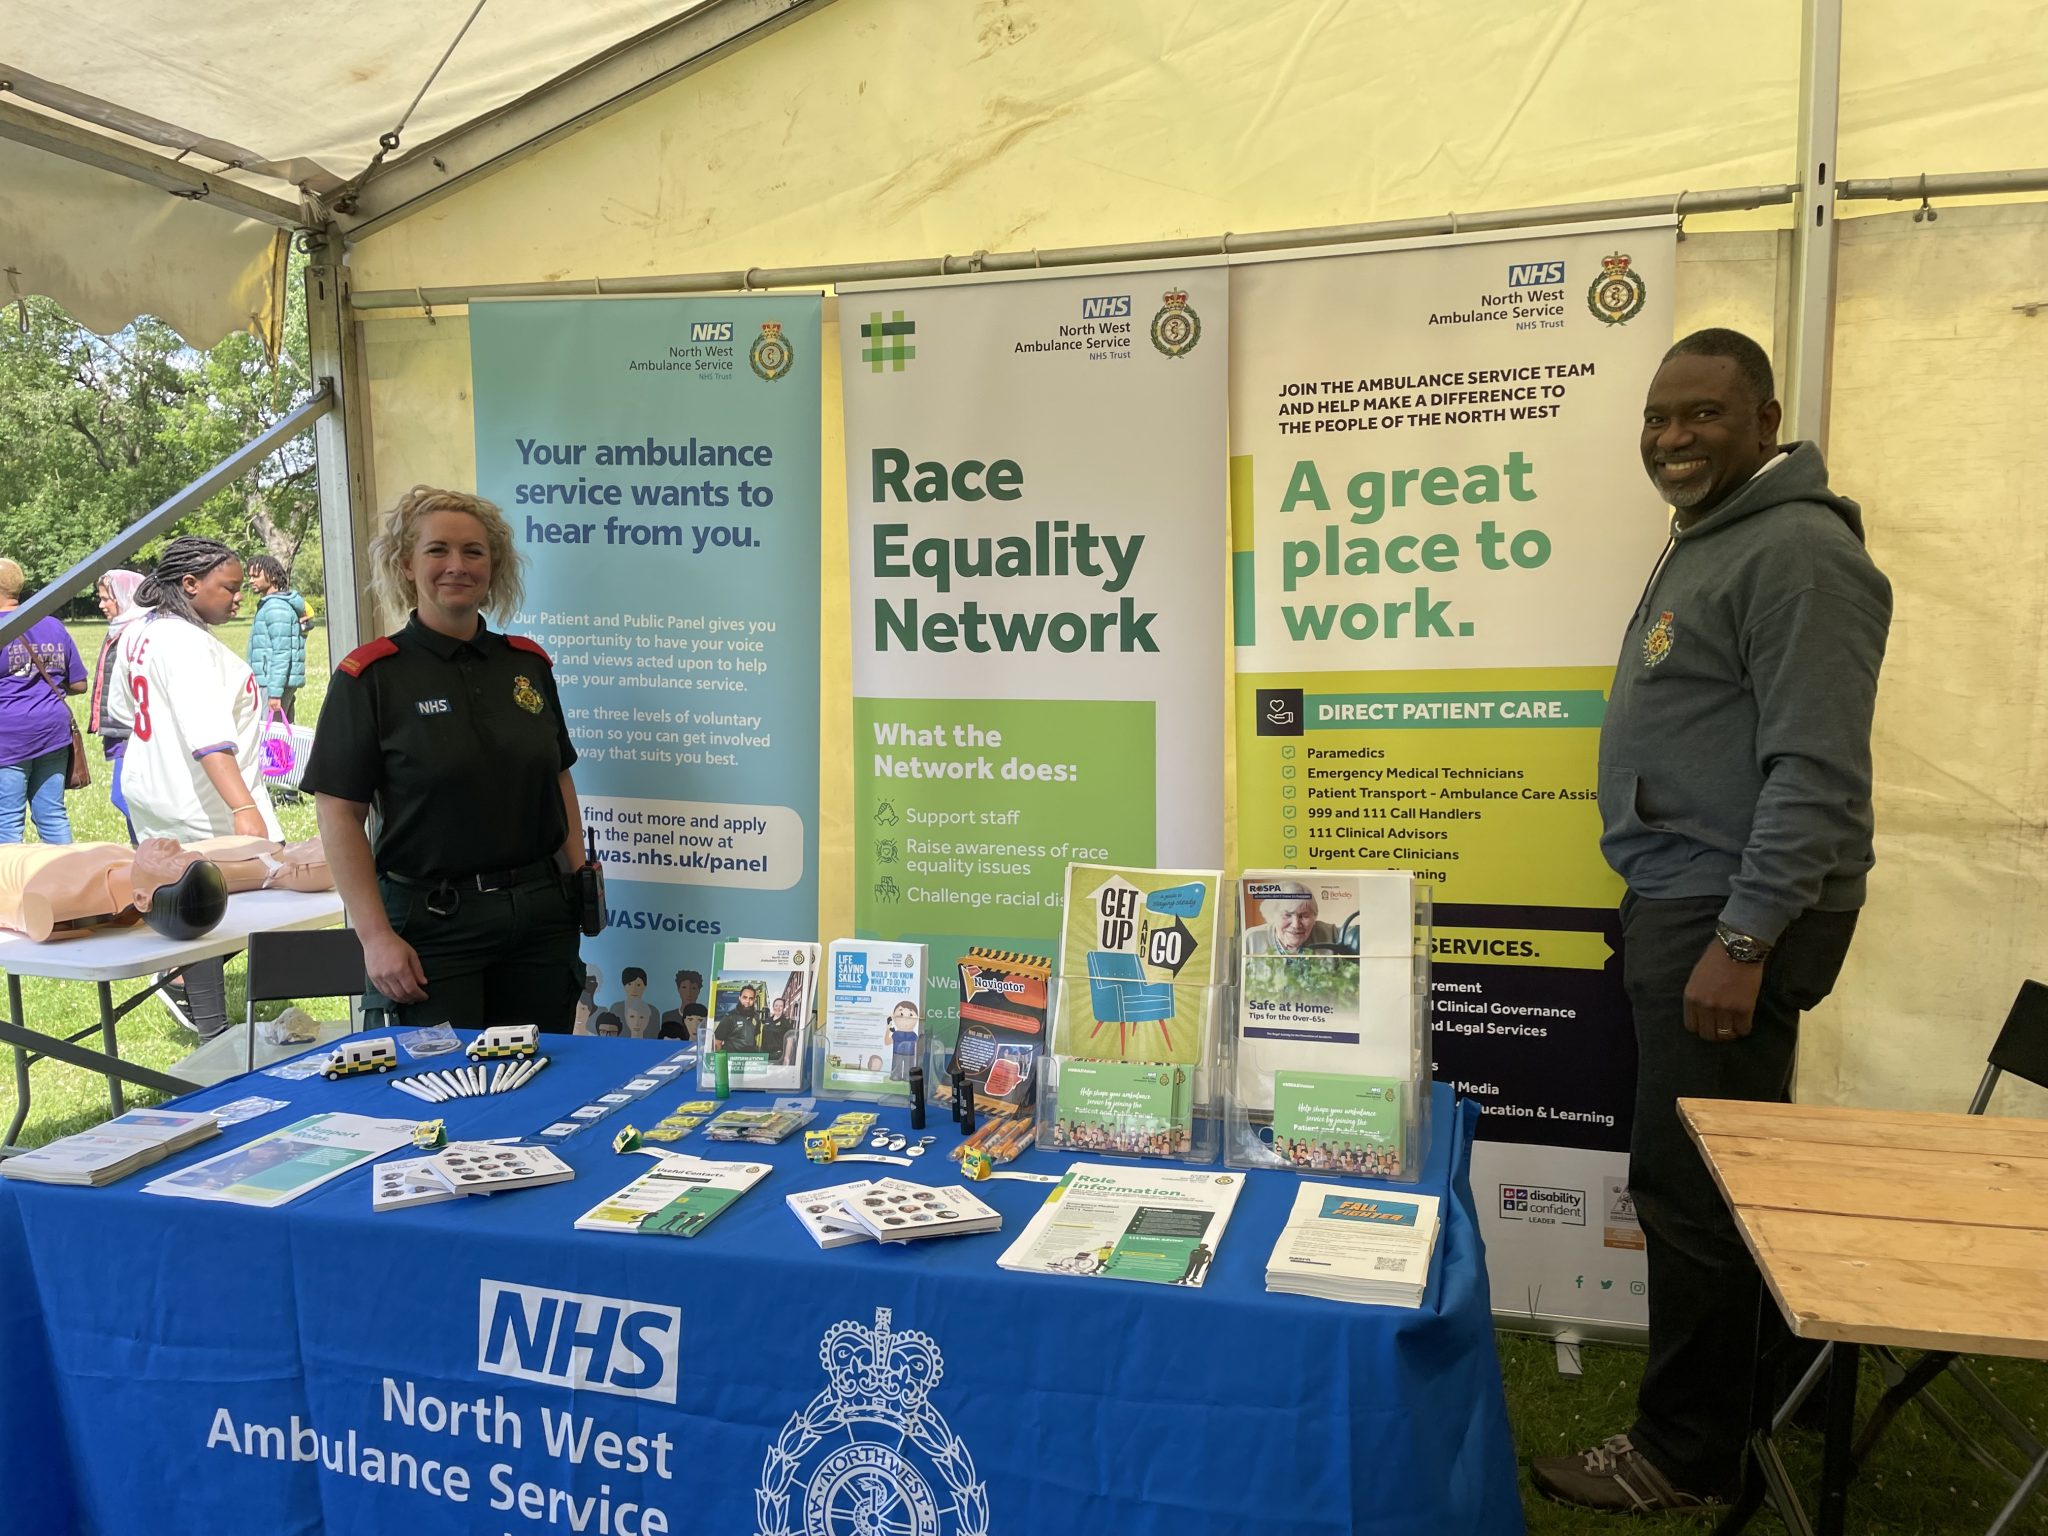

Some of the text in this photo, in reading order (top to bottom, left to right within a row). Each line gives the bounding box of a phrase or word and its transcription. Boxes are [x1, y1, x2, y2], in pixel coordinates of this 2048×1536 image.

[1509, 262, 1564, 287] NHS
[1083, 296, 1130, 319] NHS
[1482, 290, 1564, 307] North West
[1429, 305, 1564, 326] Ambulance Service
[692, 323, 733, 341] NHS
[1060, 322, 1130, 337] North West
[1516, 320, 1564, 331] NHS Trust
[670, 346, 733, 357] North West
[1015, 336, 1130, 353] Ambulance Service
[1089, 351, 1130, 360] NHS Trust
[630, 359, 733, 371] Ambulance Service
[1279, 363, 1595, 397] JOIN THE AMBULANCE SERVICE TEAM
[1279, 385, 1565, 416] AND HELP MAKE A DIFFERENCE TO
[1279, 405, 1560, 435] THE PEOPLE OF THE NORTH WEST
[516, 438, 772, 466] Your ambulance
[872, 448, 1023, 502] Race
[516, 478, 774, 507] service wants to
[1280, 451, 1537, 525] A great
[526, 516, 760, 553] hear from you.
[873, 521, 1145, 592] Equality
[1283, 521, 1551, 591] place to
[513, 612, 776, 633] Our Patient and Public Panel gives you
[1281, 587, 1474, 642] work.
[875, 597, 1160, 653] Network
[418, 700, 448, 714] NHS
[1319, 701, 1568, 721] DIRECT PATIENT CARE.
[874, 722, 1002, 747] What the
[1308, 748, 1384, 759] Paramedics
[874, 755, 1076, 782] Network does:
[1308, 767, 1524, 780] Emergency Medical Technicians
[1308, 787, 1598, 801] Patient Transport Ambulance Care Assis
[584, 807, 766, 834] find out more and apply
[906, 808, 1020, 826] Support staff
[1308, 807, 1481, 820] 999 and 111 Call Handlers
[1309, 827, 1447, 840] 111 Clinical Advisors
[907, 839, 1108, 860] Raise awareness of race
[1309, 847, 1459, 861] Urgent Care Clinicians
[907, 858, 1030, 876] equality issues
[908, 887, 1040, 907] Challenge racial
[1101, 888, 1139, 919] GET
[1102, 919, 1133, 949] UP
[1140, 920, 1148, 958] AND
[1151, 932, 1182, 964] GO
[1432, 938, 1540, 957] SERVICES.
[839, 955, 853, 964] LIFE
[839, 964, 864, 973] SAVING
[839, 974, 861, 983] SKILLS
[974, 977, 1025, 992] Navigator
[1250, 1000, 1333, 1014] Safe at Home:
[1438, 1000, 1576, 1019] Clinical Governance
[1249, 1013, 1264, 1021] Tips
[1447, 1021, 1547, 1037] Legal Services
[1458, 1082, 1499, 1095] Media
[1537, 1107, 1614, 1127] & Learning
[657, 1167, 684, 1175] Useful
[1078, 1175, 1116, 1184] Role
[1072, 1182, 1186, 1196] information.
[1339, 1201, 1378, 1212] FALL
[1530, 1191, 1581, 1206] disability
[1332, 1209, 1403, 1221] FIGHTER
[1530, 1203, 1581, 1217] confident
[1529, 1217, 1555, 1225] LEADER
[483, 1289, 673, 1390] NHS
[383, 1378, 673, 1480] North West
[207, 1408, 668, 1536] Ambulance Service
